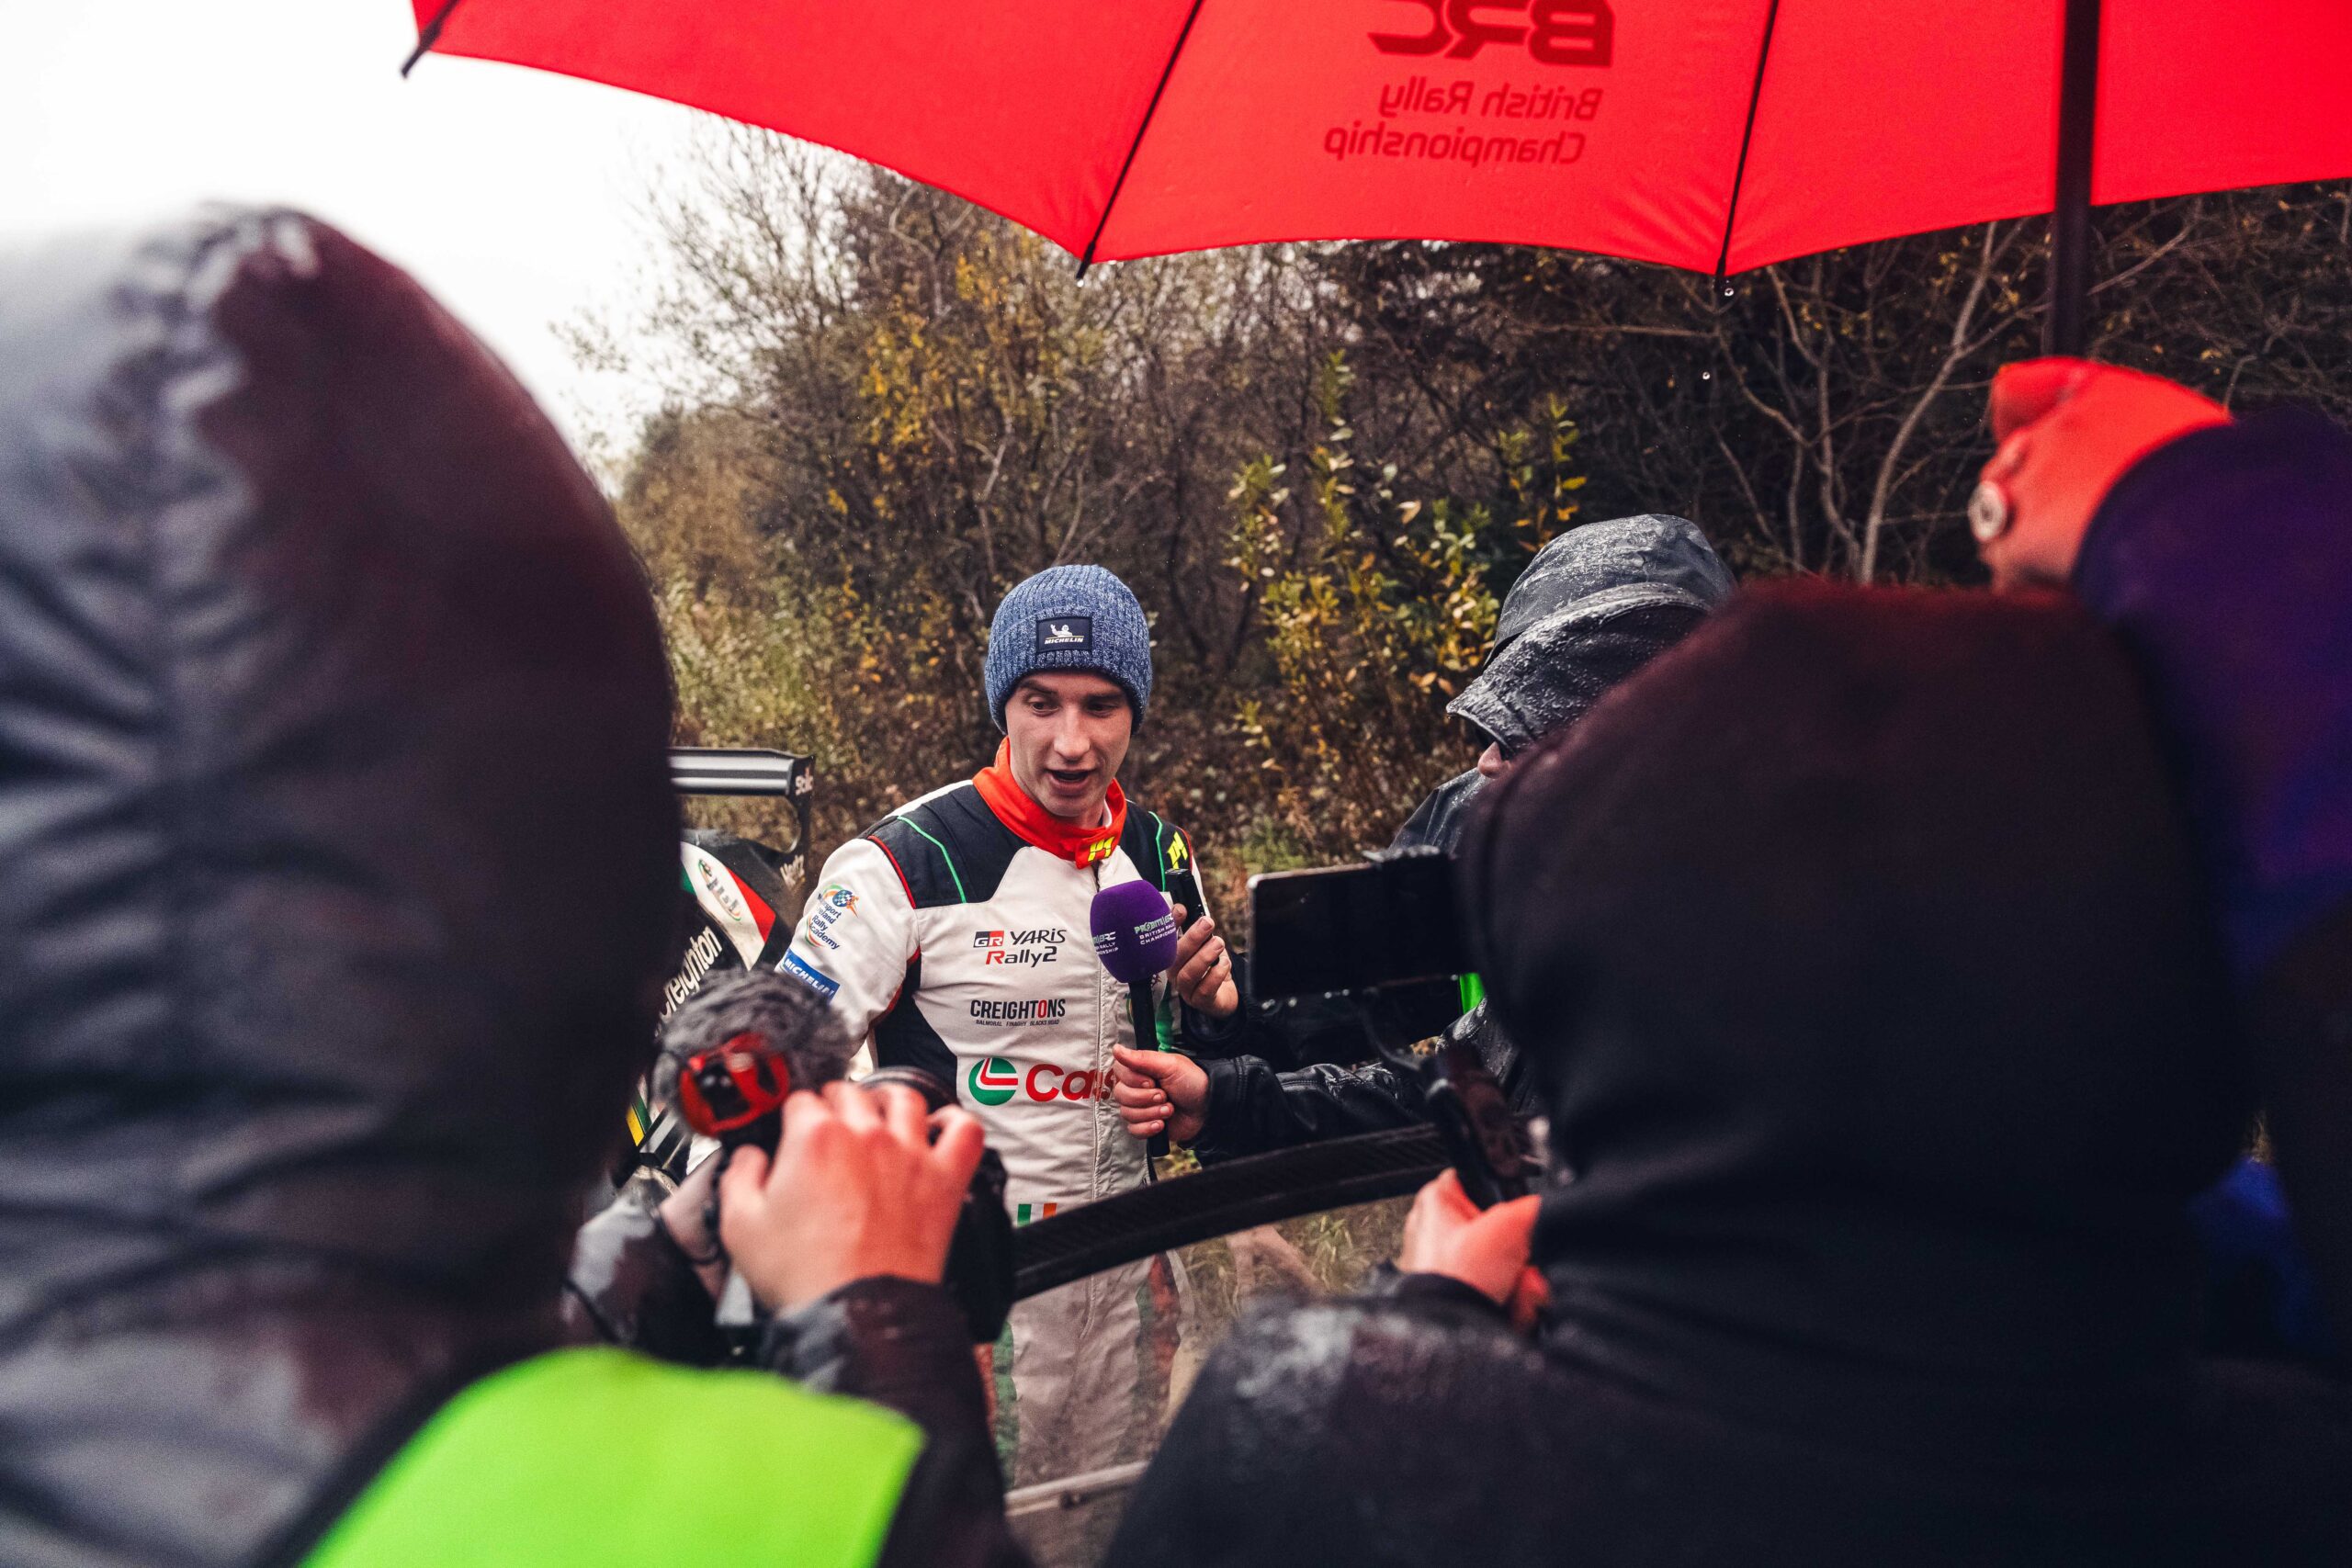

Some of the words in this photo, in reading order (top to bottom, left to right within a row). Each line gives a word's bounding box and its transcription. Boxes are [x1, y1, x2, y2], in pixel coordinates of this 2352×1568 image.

[812, 915, 829, 931] Rally
[1139, 928, 1165, 940] BRITISH
[986, 946, 1057, 967] Rally2
[970, 998, 1066, 1020] CREIGHTONS
